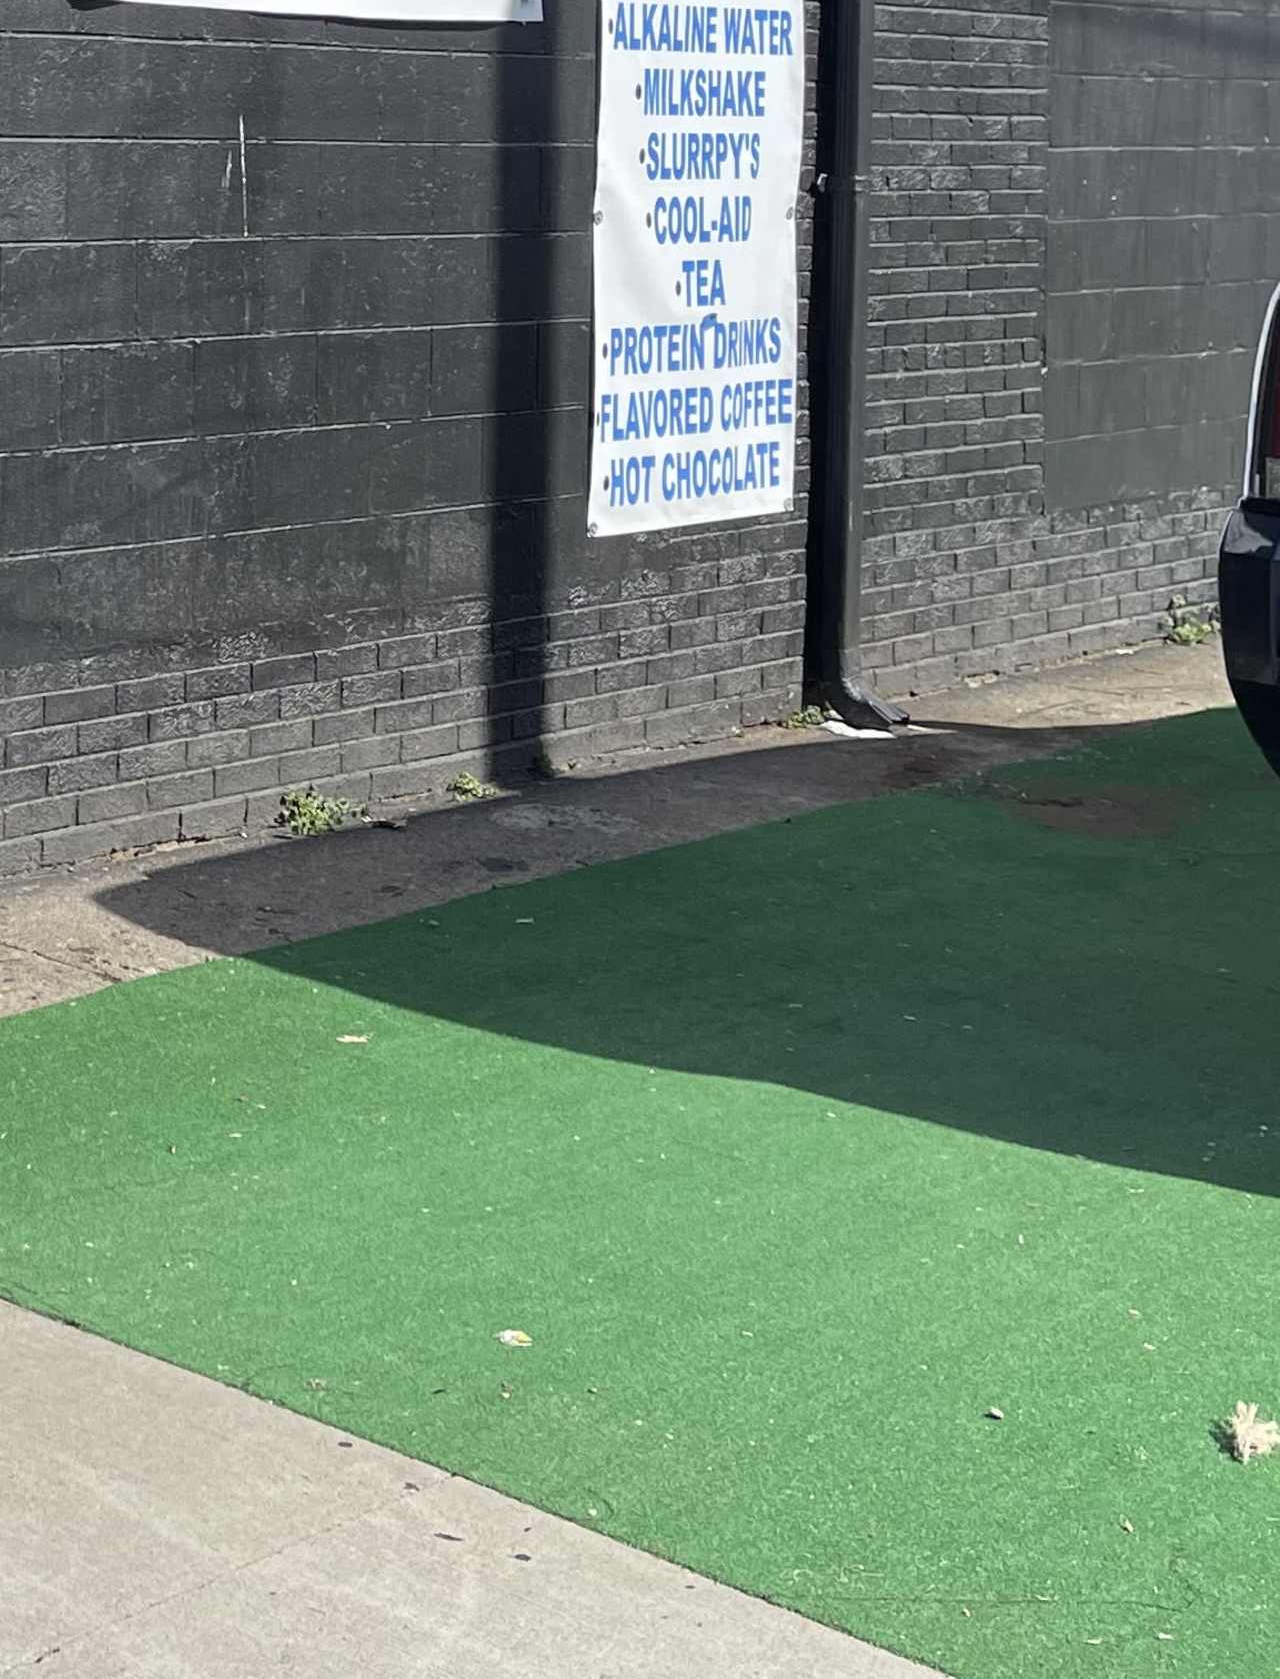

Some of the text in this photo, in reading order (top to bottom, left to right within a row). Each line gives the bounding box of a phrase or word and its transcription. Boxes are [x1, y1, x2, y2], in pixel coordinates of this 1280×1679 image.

[613, 1, 793, 56] ALKALINE WATER
[643, 68, 766, 117] MILKSHAKE
[646, 132, 760, 181] SLURRPY'S
[653, 195, 752, 245] COOL-AID
[681, 259, 726, 307] TEA
[610, 317, 781, 376] PROTEIN DRINKS
[600, 378, 793, 443] FLAVORED COFFEE
[610, 441, 780, 508] HOT CHOCOLATE
